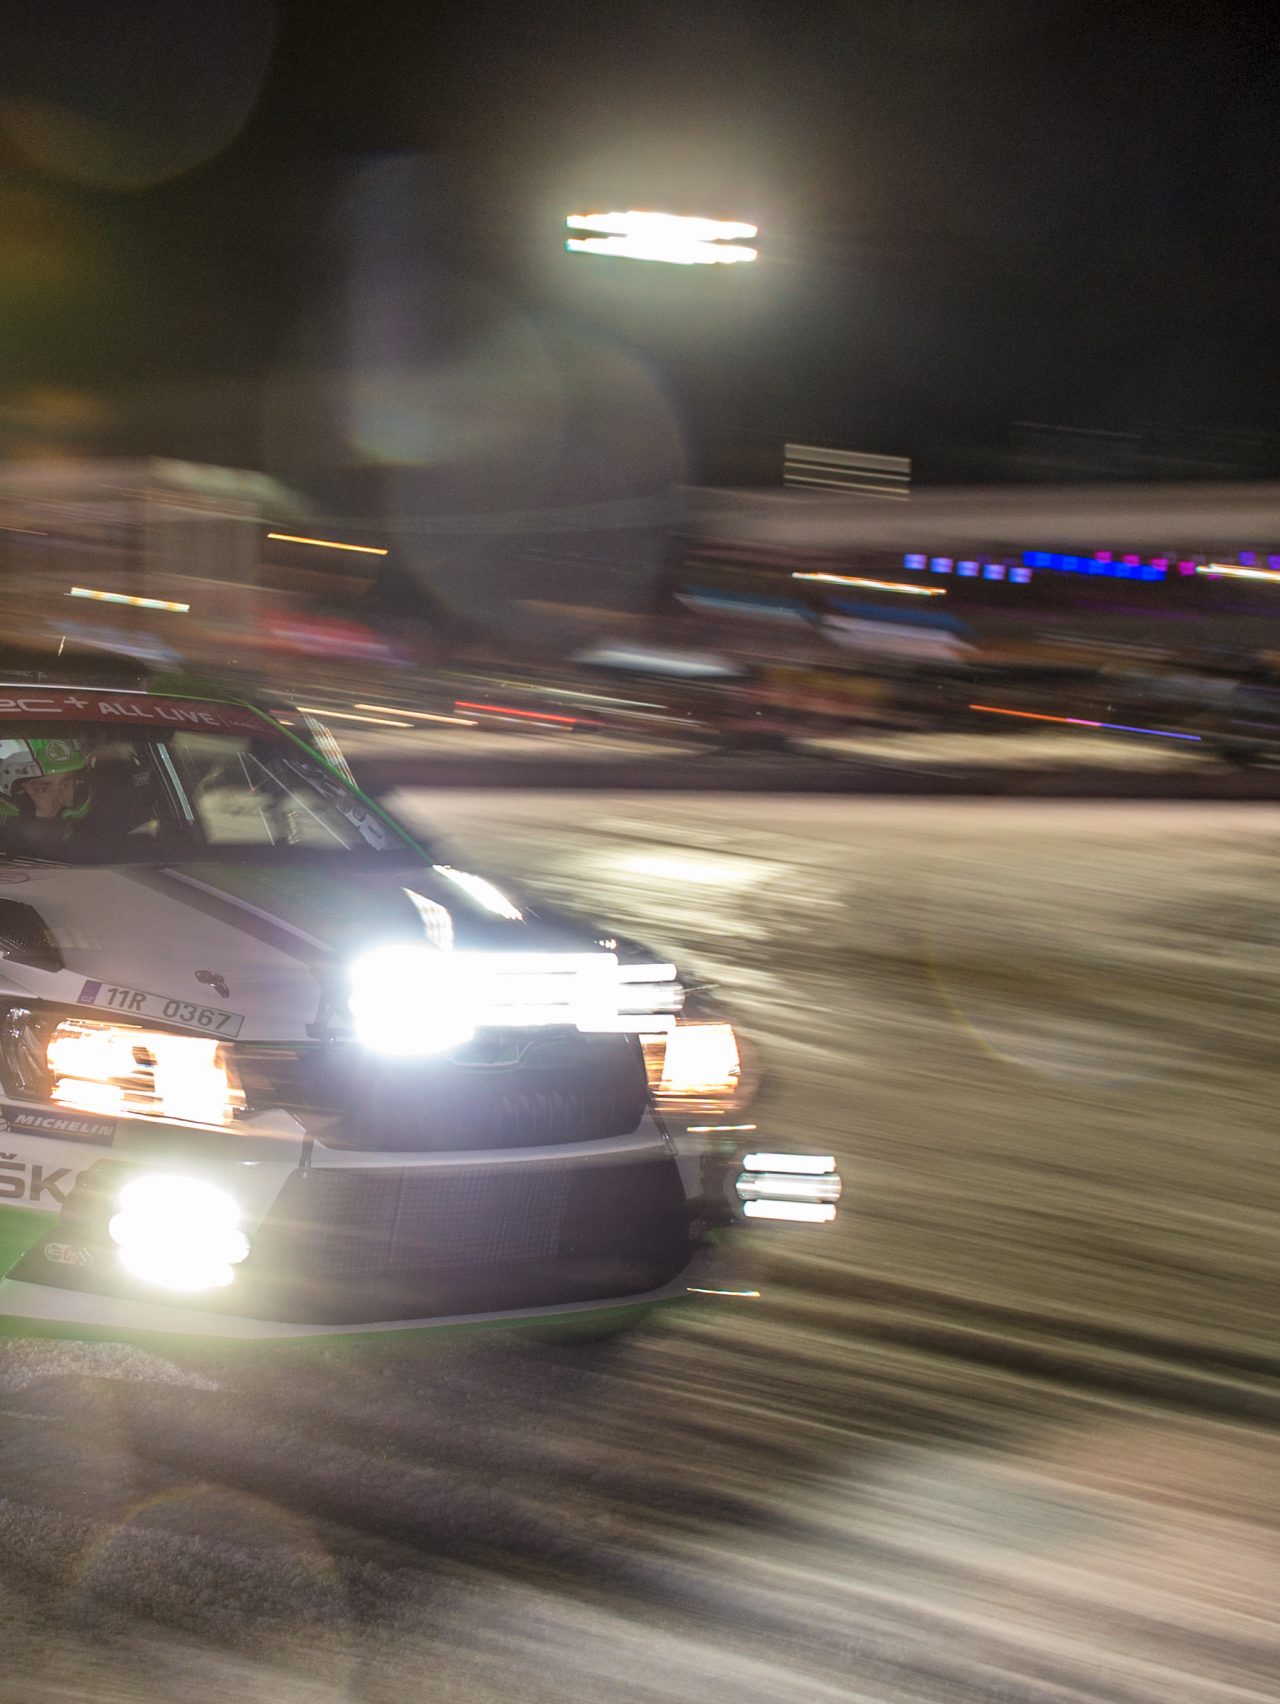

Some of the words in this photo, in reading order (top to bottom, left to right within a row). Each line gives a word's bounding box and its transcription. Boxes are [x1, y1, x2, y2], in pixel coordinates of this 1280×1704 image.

[97, 701, 154, 719] ALL
[154, 706, 221, 727] LIVE
[106, 988, 147, 1012] 11R
[162, 1000, 234, 1031] 0367
[13, 1113, 115, 1136] MICHELIN
